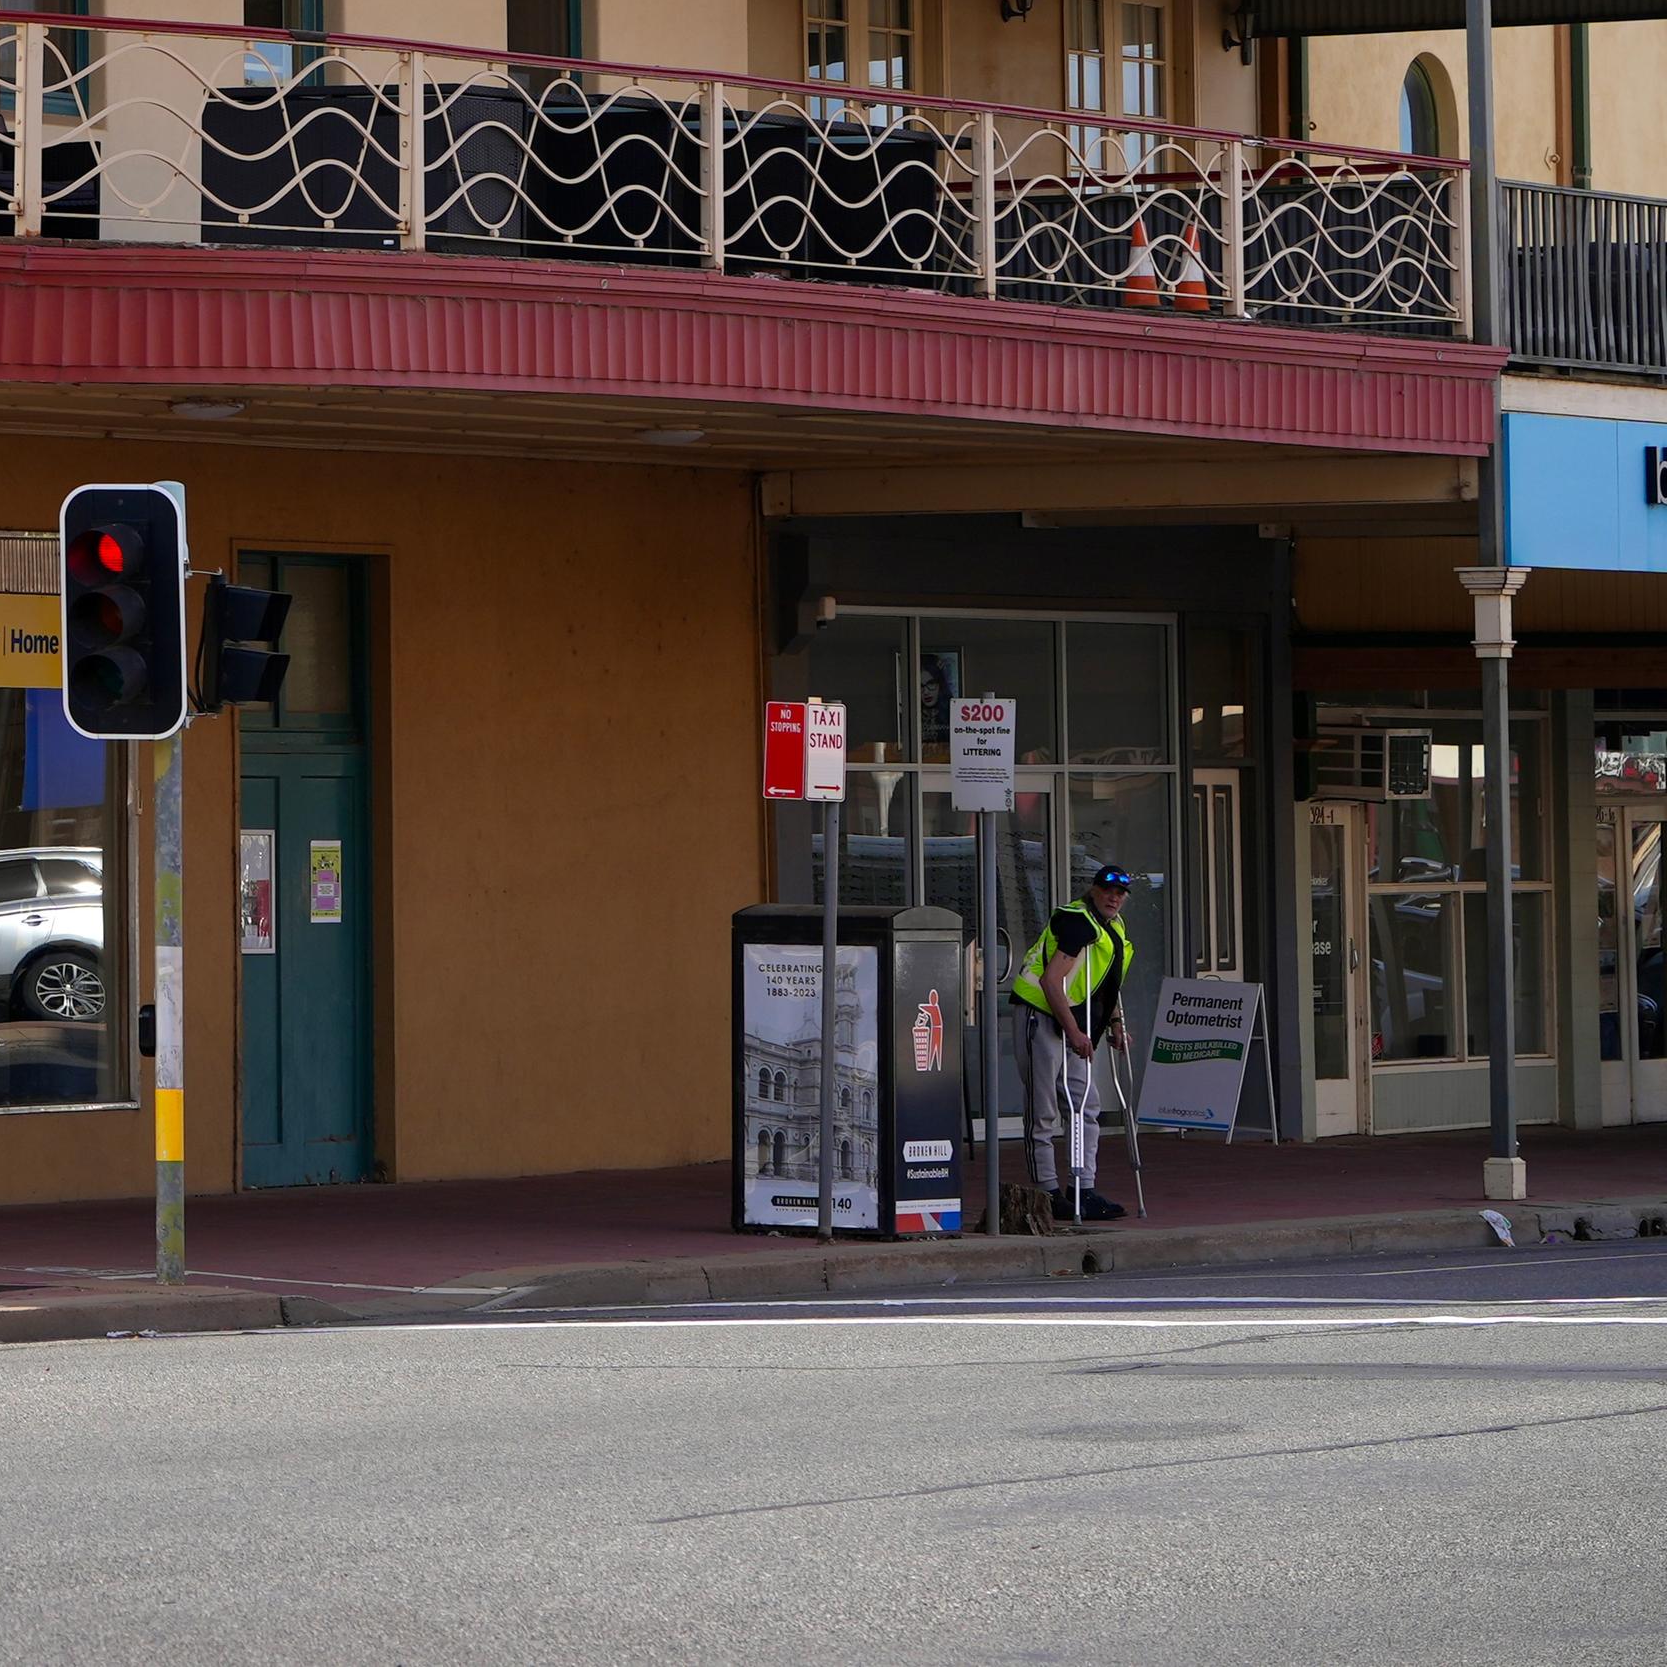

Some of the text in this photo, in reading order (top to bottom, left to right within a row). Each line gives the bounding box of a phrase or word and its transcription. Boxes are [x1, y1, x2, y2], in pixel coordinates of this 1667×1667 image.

[11, 629, 59, 654] Home
[780, 709, 792, 720] NO
[813, 710, 840, 726] TAXI
[961, 704, 1004, 722] $200
[770, 722, 801, 733] STOPPING
[954, 726, 1010, 735] on-the-spot fine
[809, 733, 843, 749] STAND
[977, 737, 987, 745] for
[963, 748, 1001, 756] LITTERING
[758, 963, 823, 973] CELEBRATING
[766, 976, 816, 985] 140 YEARS
[767, 988, 816, 997] 1883-2023
[1172, 992, 1243, 1011] Permanent
[1166, 1010, 1243, 1029] Optometrist
[1157, 1041, 1238, 1051] EYETESTS BULKBILLED
[1171, 1049, 1220, 1061] TO MEDICARE
[909, 1145, 947, 1157] BROKEN HILL
[776, 1197, 816, 1206] BROKEN HILL
